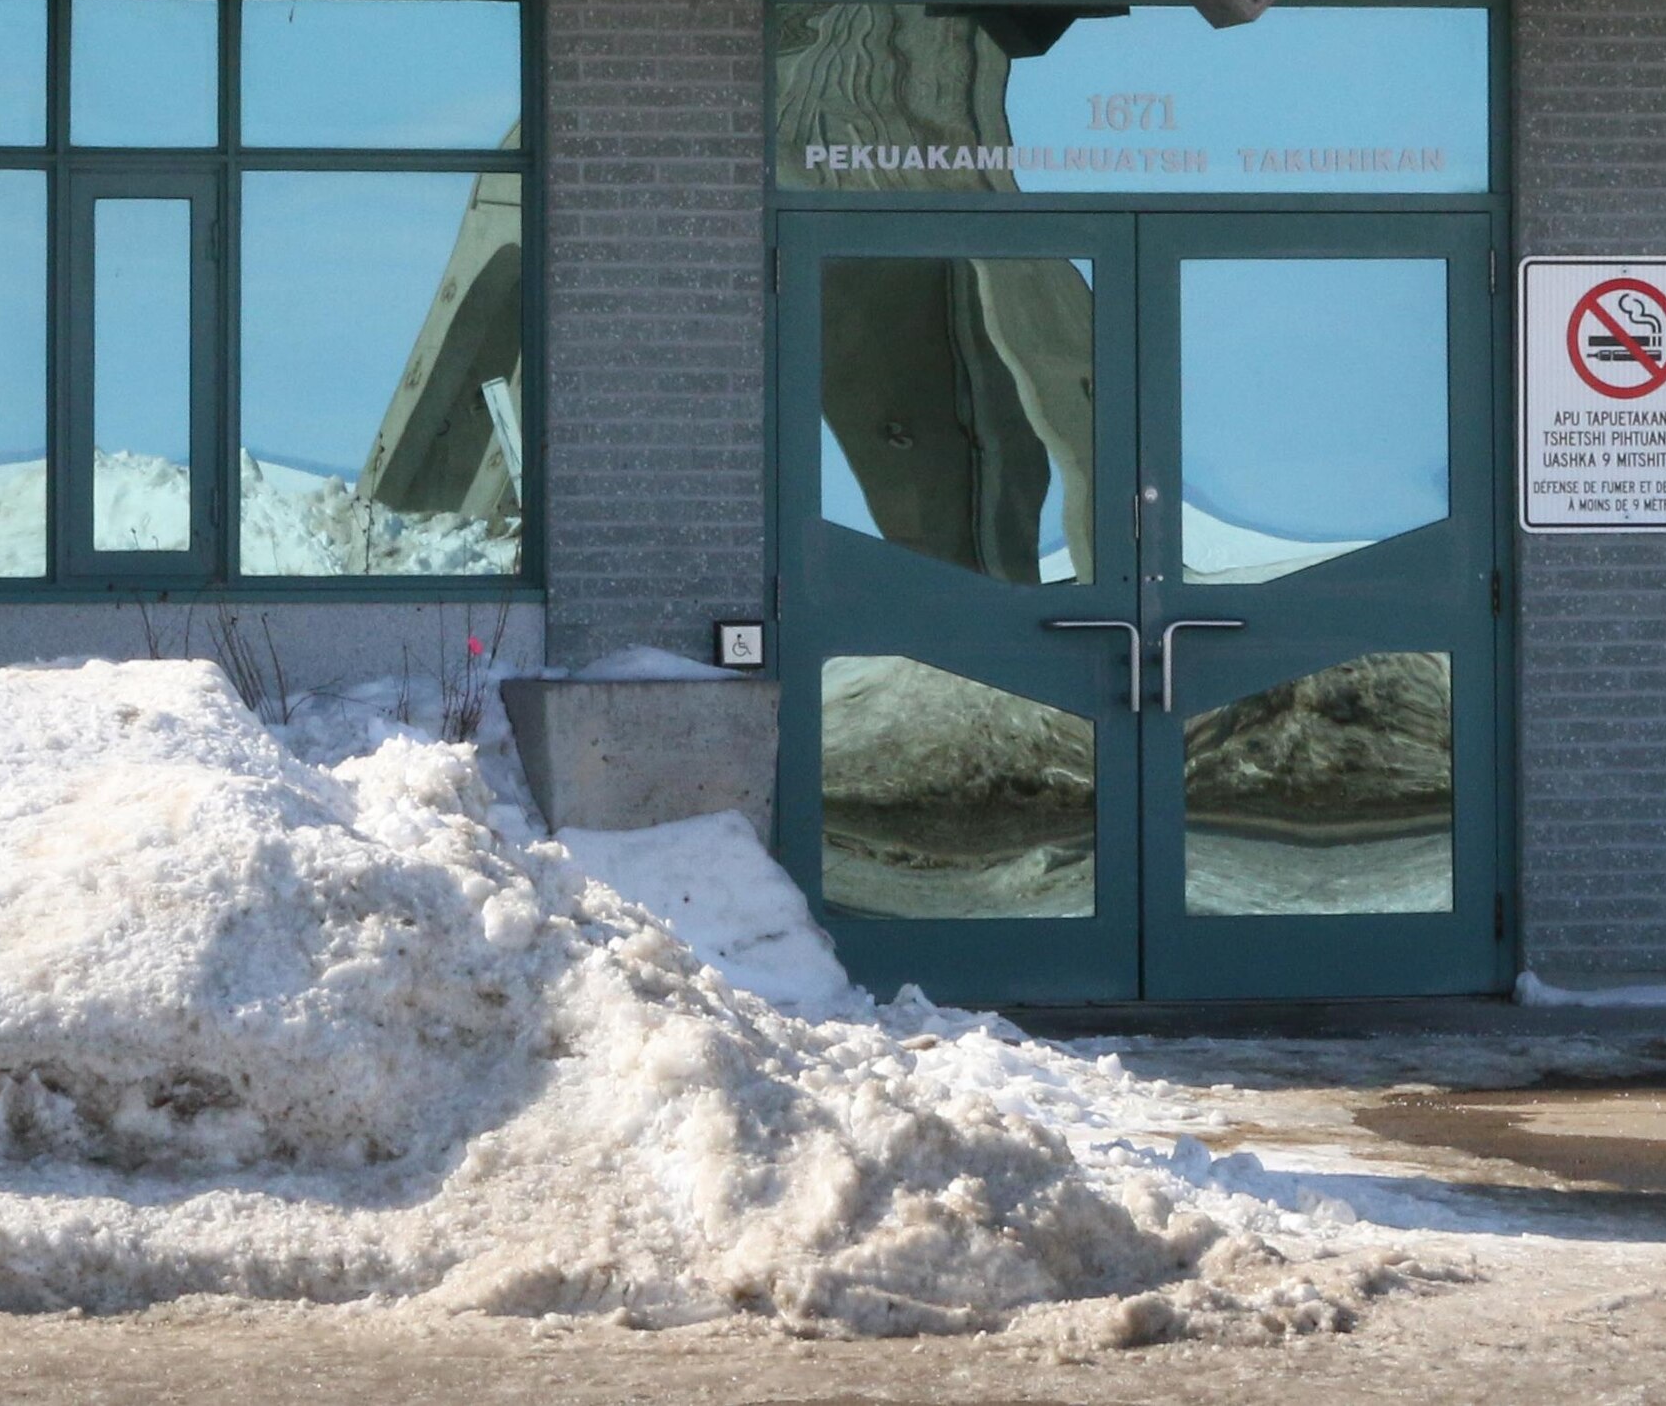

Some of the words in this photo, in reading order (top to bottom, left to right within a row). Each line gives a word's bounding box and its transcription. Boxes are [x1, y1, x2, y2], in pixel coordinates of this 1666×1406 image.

[1086, 93, 1178, 131] 1671
[805, 144, 1208, 174] PEKUAKAMIULNUATSH
[1238, 147, 1446, 174] TAKUHIKAN
[1554, 411, 1580, 426] APU
[1543, 431, 1606, 446] TSHETSHI
[1543, 452, 1597, 467] UASHKA
[1602, 452, 1611, 467] 9
[1583, 480, 1597, 494] DE
[1601, 480, 1636, 494] FUMER
[1640, 480, 1651, 494] ET
[1568, 496, 1575, 511] À
[1579, 498, 1611, 511] MOINS
[1615, 498, 1628, 511] DE
[1633, 498, 1640, 511] 9
